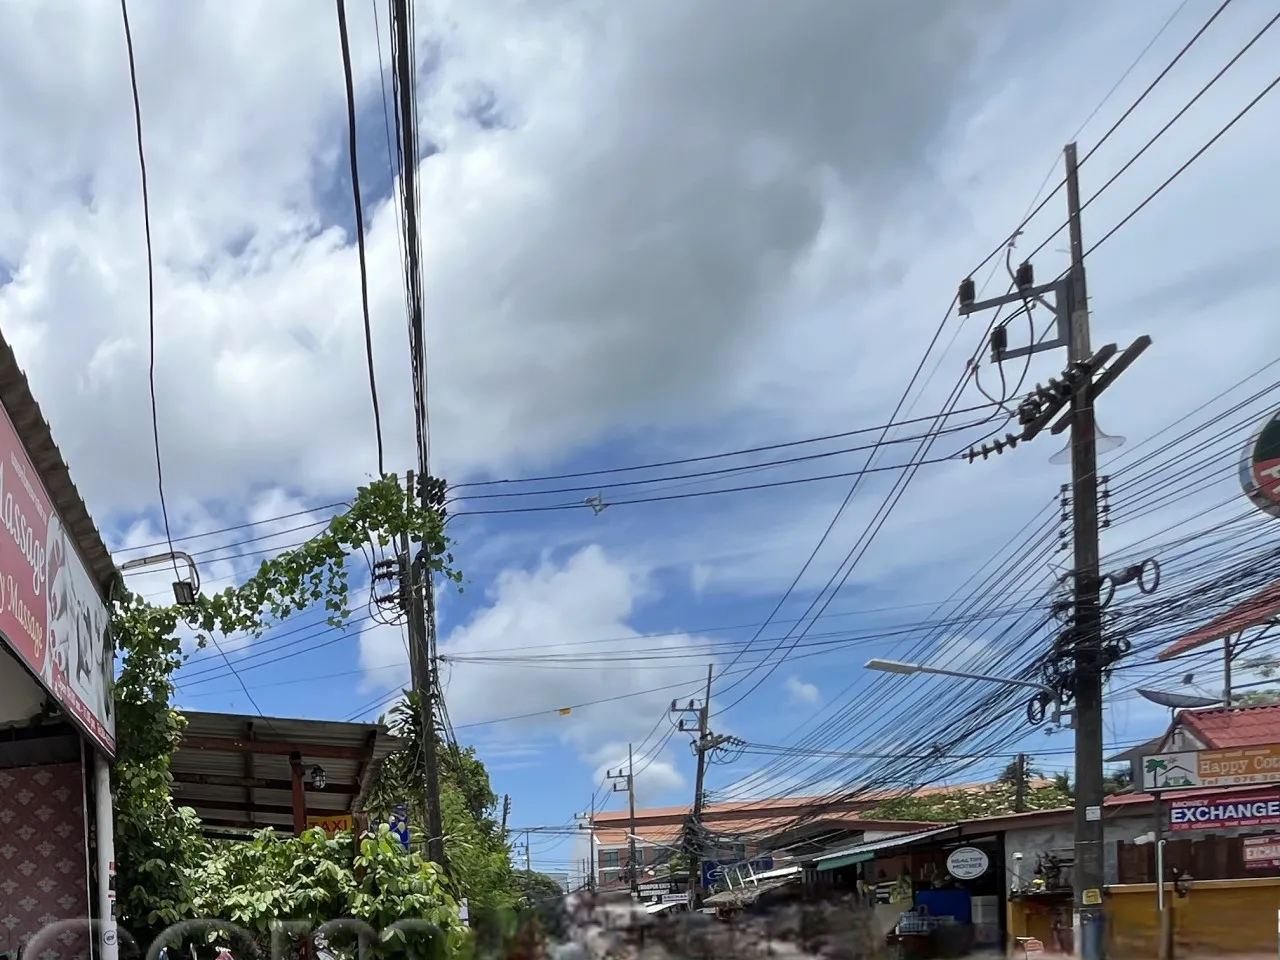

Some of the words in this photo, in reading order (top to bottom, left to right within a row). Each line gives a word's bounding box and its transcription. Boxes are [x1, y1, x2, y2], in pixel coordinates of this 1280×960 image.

[6, 579, 44, 659] Massage
[1200, 758, 1249, 776] Happy
[1170, 801, 1280, 823] EXCHANGE
